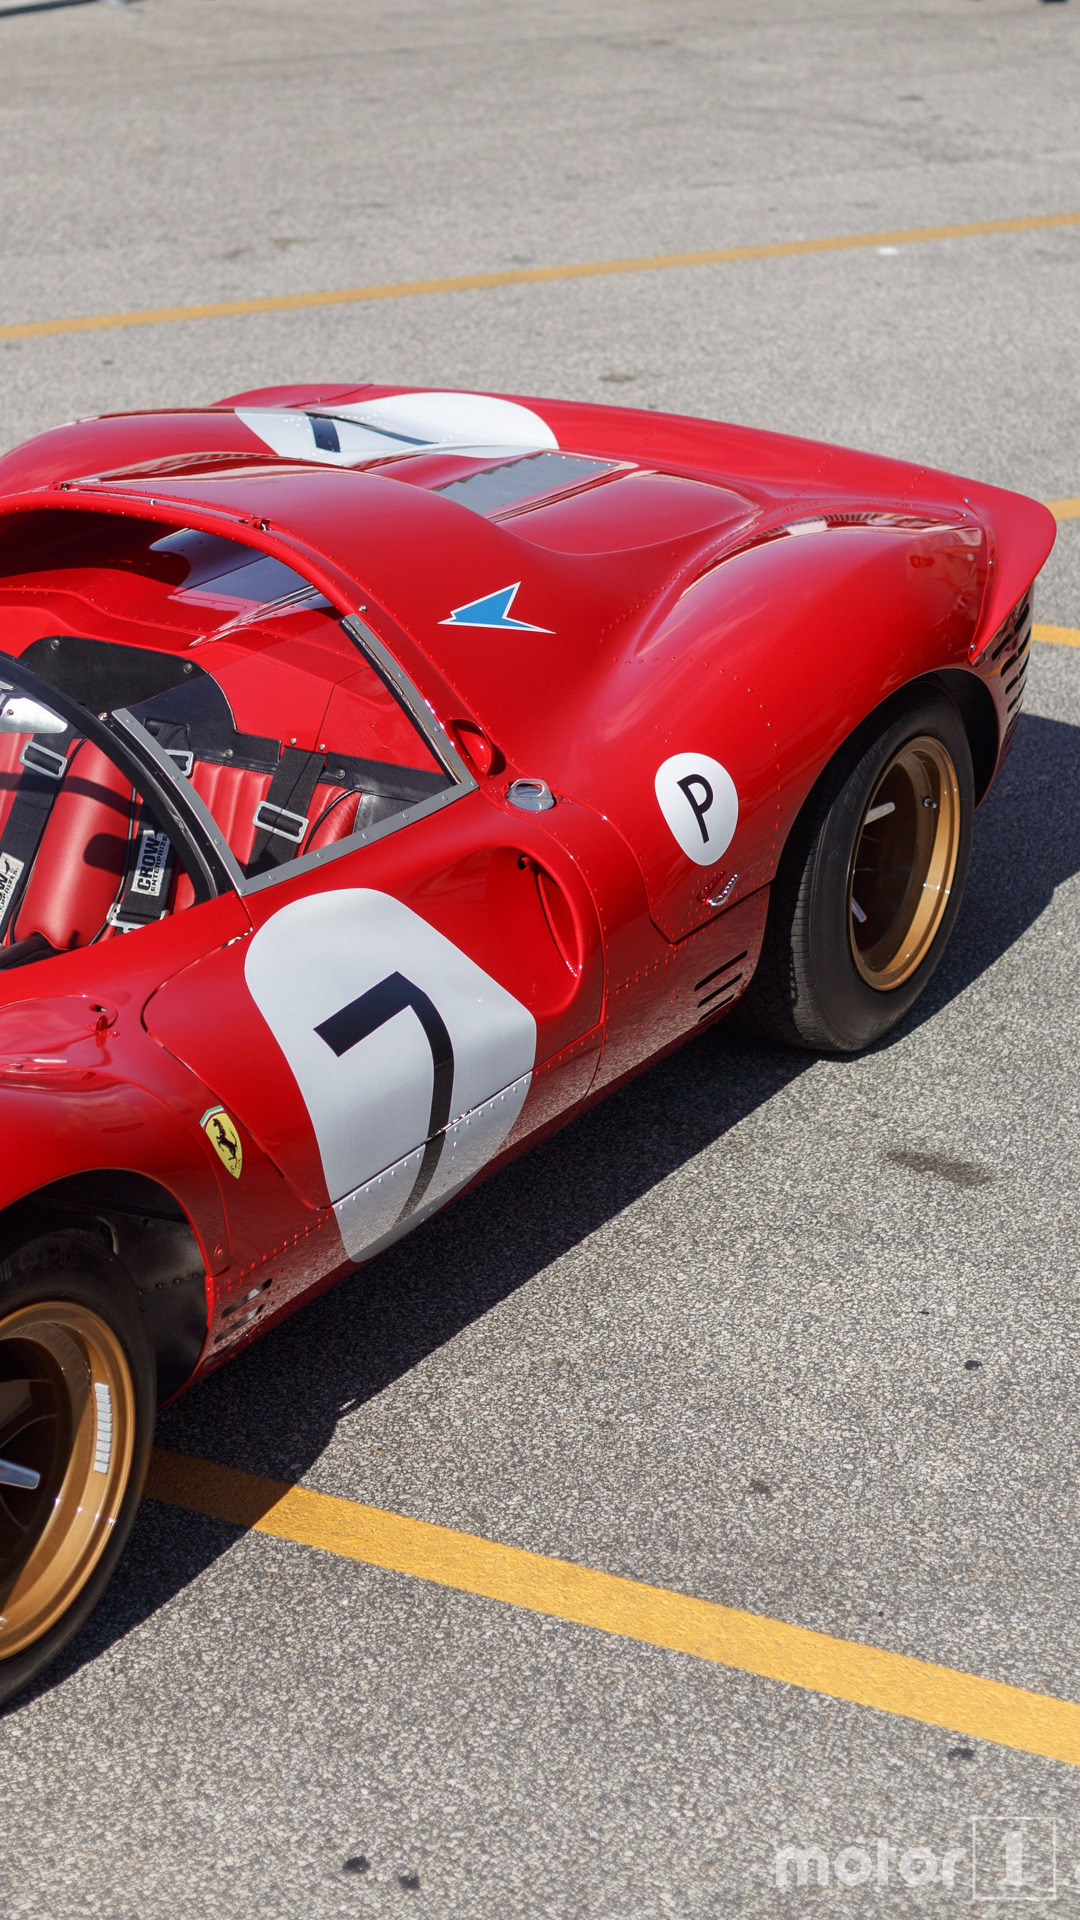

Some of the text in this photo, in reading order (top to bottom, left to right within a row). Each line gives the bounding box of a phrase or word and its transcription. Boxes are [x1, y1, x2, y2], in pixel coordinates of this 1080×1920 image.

[677, 774, 713, 844] P
[137, 836, 160, 890] CROW
[313, 971, 454, 1228] 7
